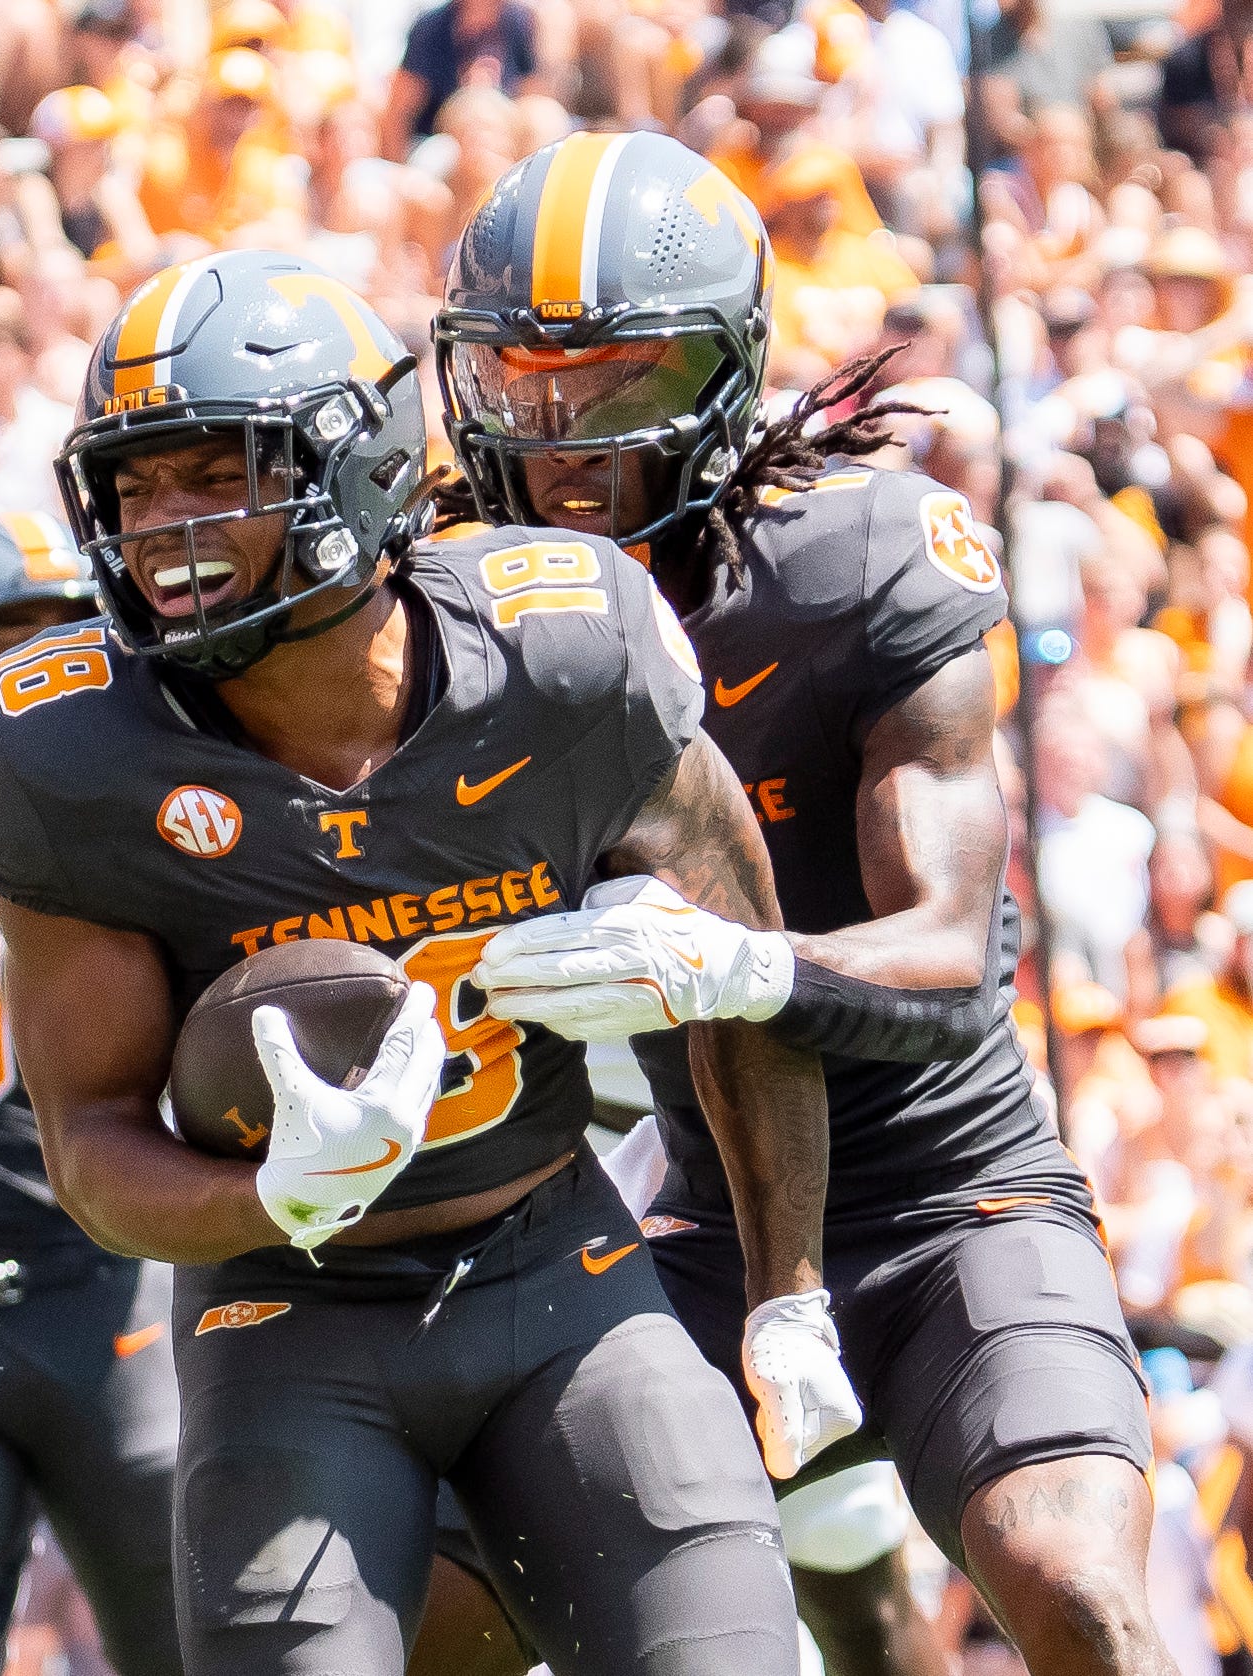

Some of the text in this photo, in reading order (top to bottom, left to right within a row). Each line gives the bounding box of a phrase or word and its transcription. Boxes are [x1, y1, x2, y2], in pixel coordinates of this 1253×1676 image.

[540, 303, 583, 318] VOLS
[479, 541, 609, 631] 18
[164, 790, 236, 854] SEC
[319, 810, 369, 859] T
[232, 861, 560, 957] TENNESSEE
